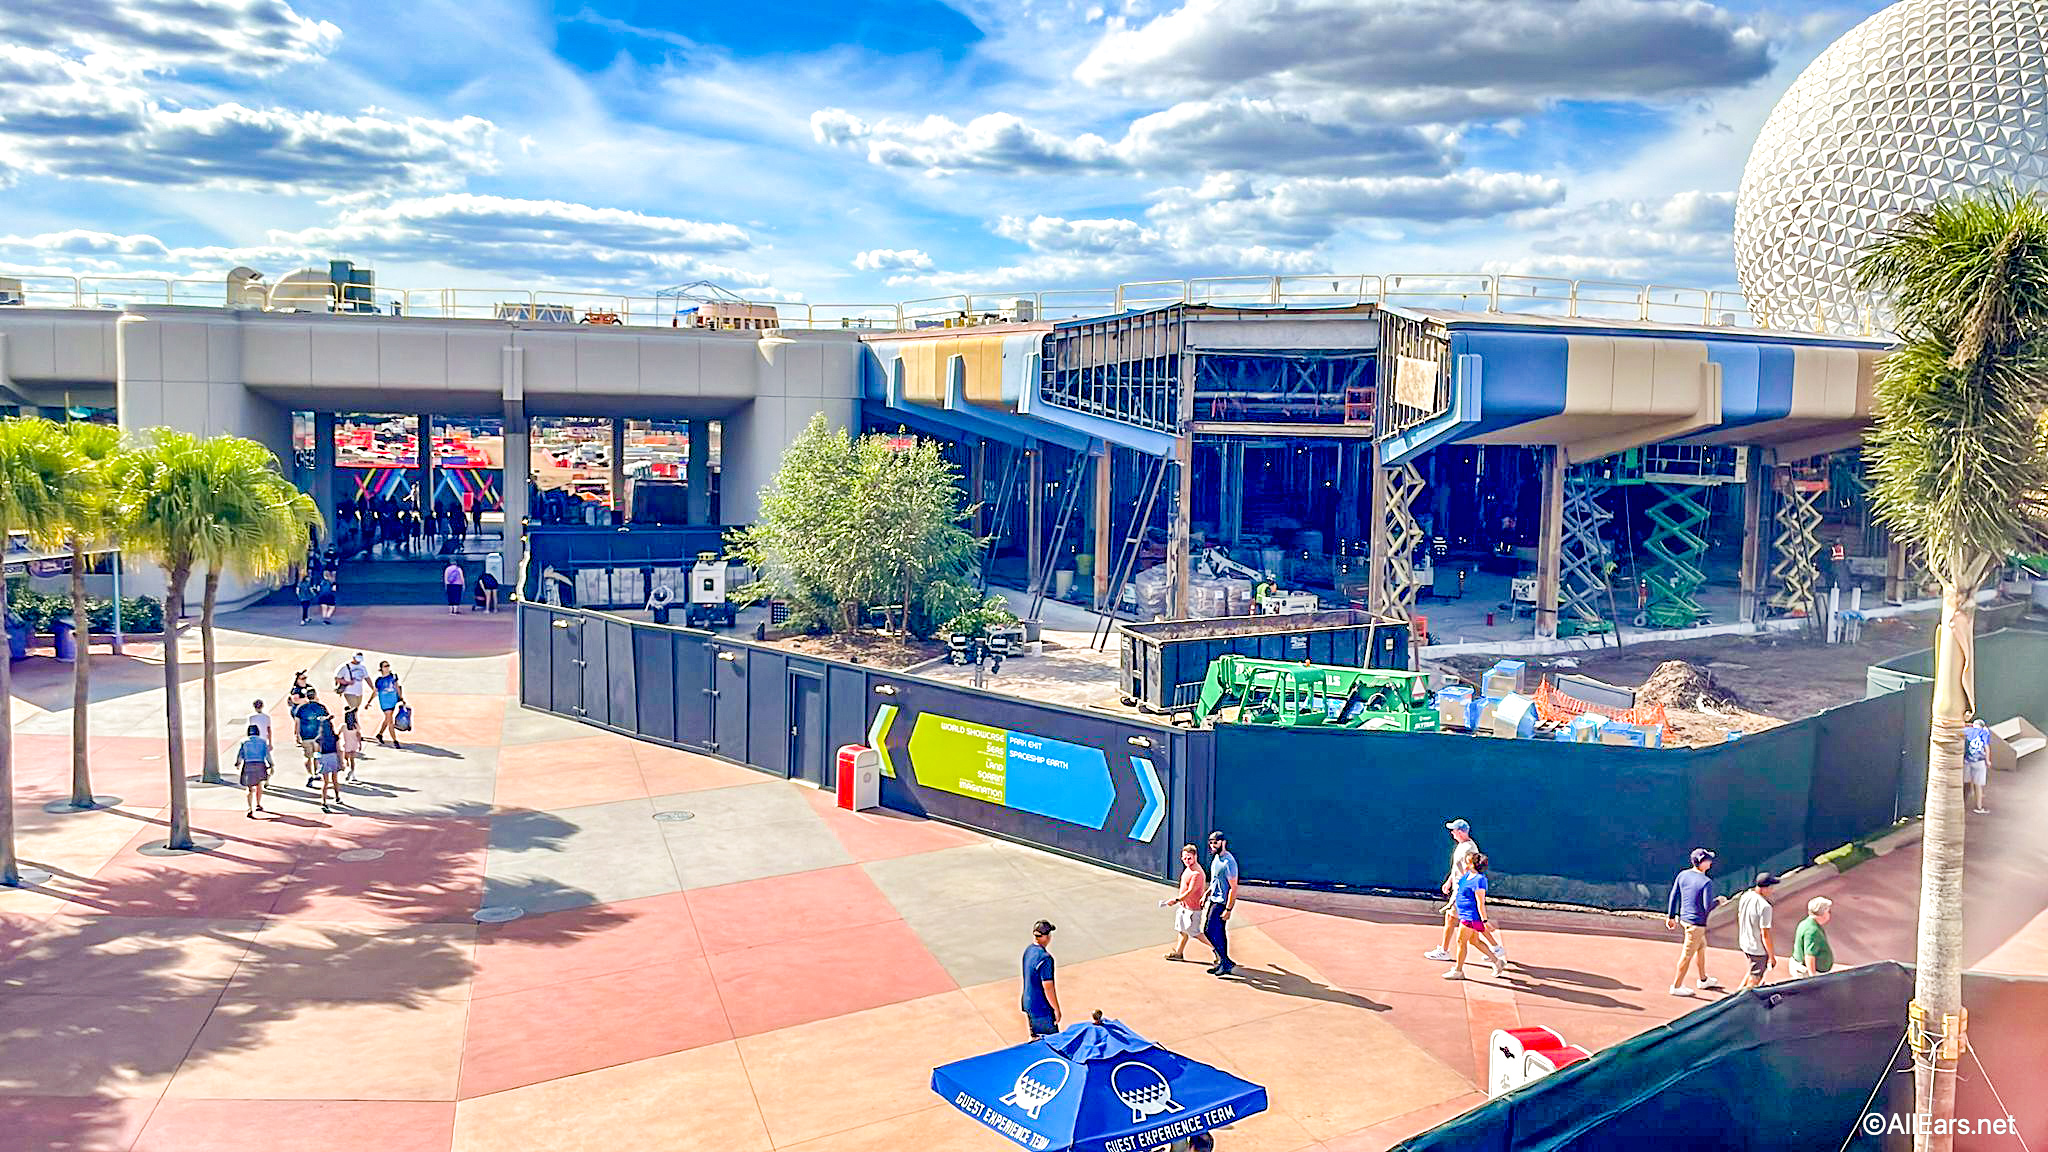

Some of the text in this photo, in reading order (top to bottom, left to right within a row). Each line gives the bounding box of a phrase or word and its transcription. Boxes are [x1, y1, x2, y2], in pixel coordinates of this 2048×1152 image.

[941, 722, 1004, 742] WORLD SHOWCASE
[986, 744, 1004, 755] SEAS
[1009, 736, 1042, 750] PARK EXIT
[985, 761, 1004, 772] LAND
[1009, 750, 1045, 763] SPACESHIP
[1045, 758, 1069, 770] EARTH
[959, 781, 1002, 798] IMAGINATION
[955, 1091, 1051, 1151] GUEST EXPERIENCE TEAM
[1105, 1104, 1236, 1152] GUEST EXPERIENCE TEAM
